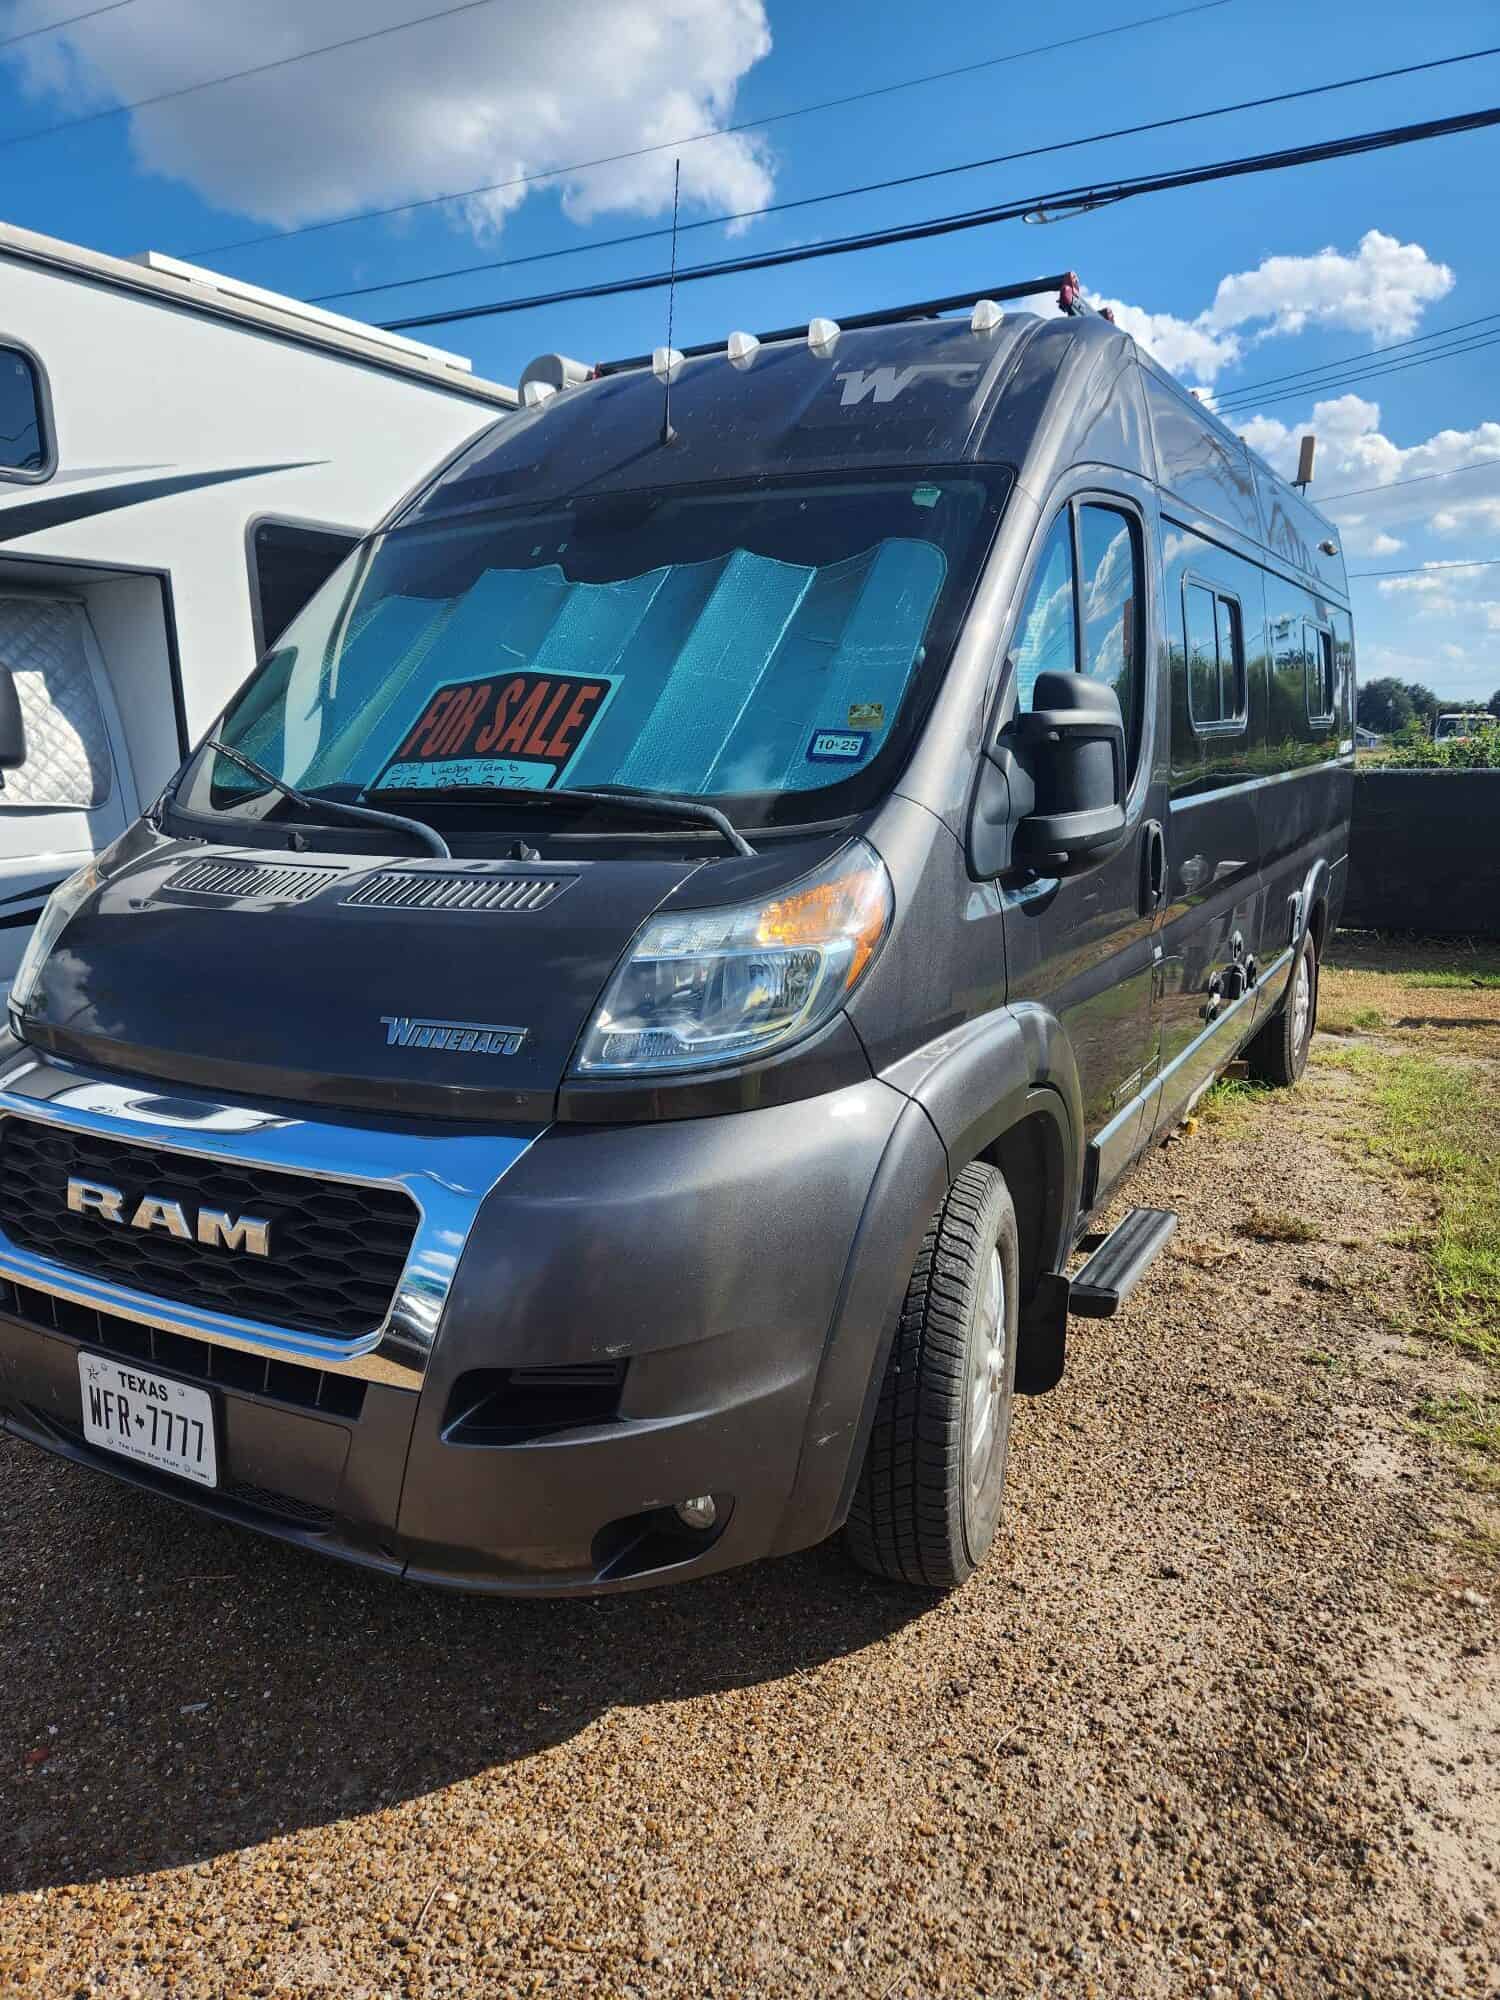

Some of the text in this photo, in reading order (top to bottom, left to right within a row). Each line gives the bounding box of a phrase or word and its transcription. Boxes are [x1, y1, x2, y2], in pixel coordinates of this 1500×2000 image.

[400, 678, 600, 757] FOR SALE
[67, 1176, 271, 1257] RAM
[89, 1385, 204, 1463] WFR 7777
[117, 1371, 169, 1402] TEXAS
